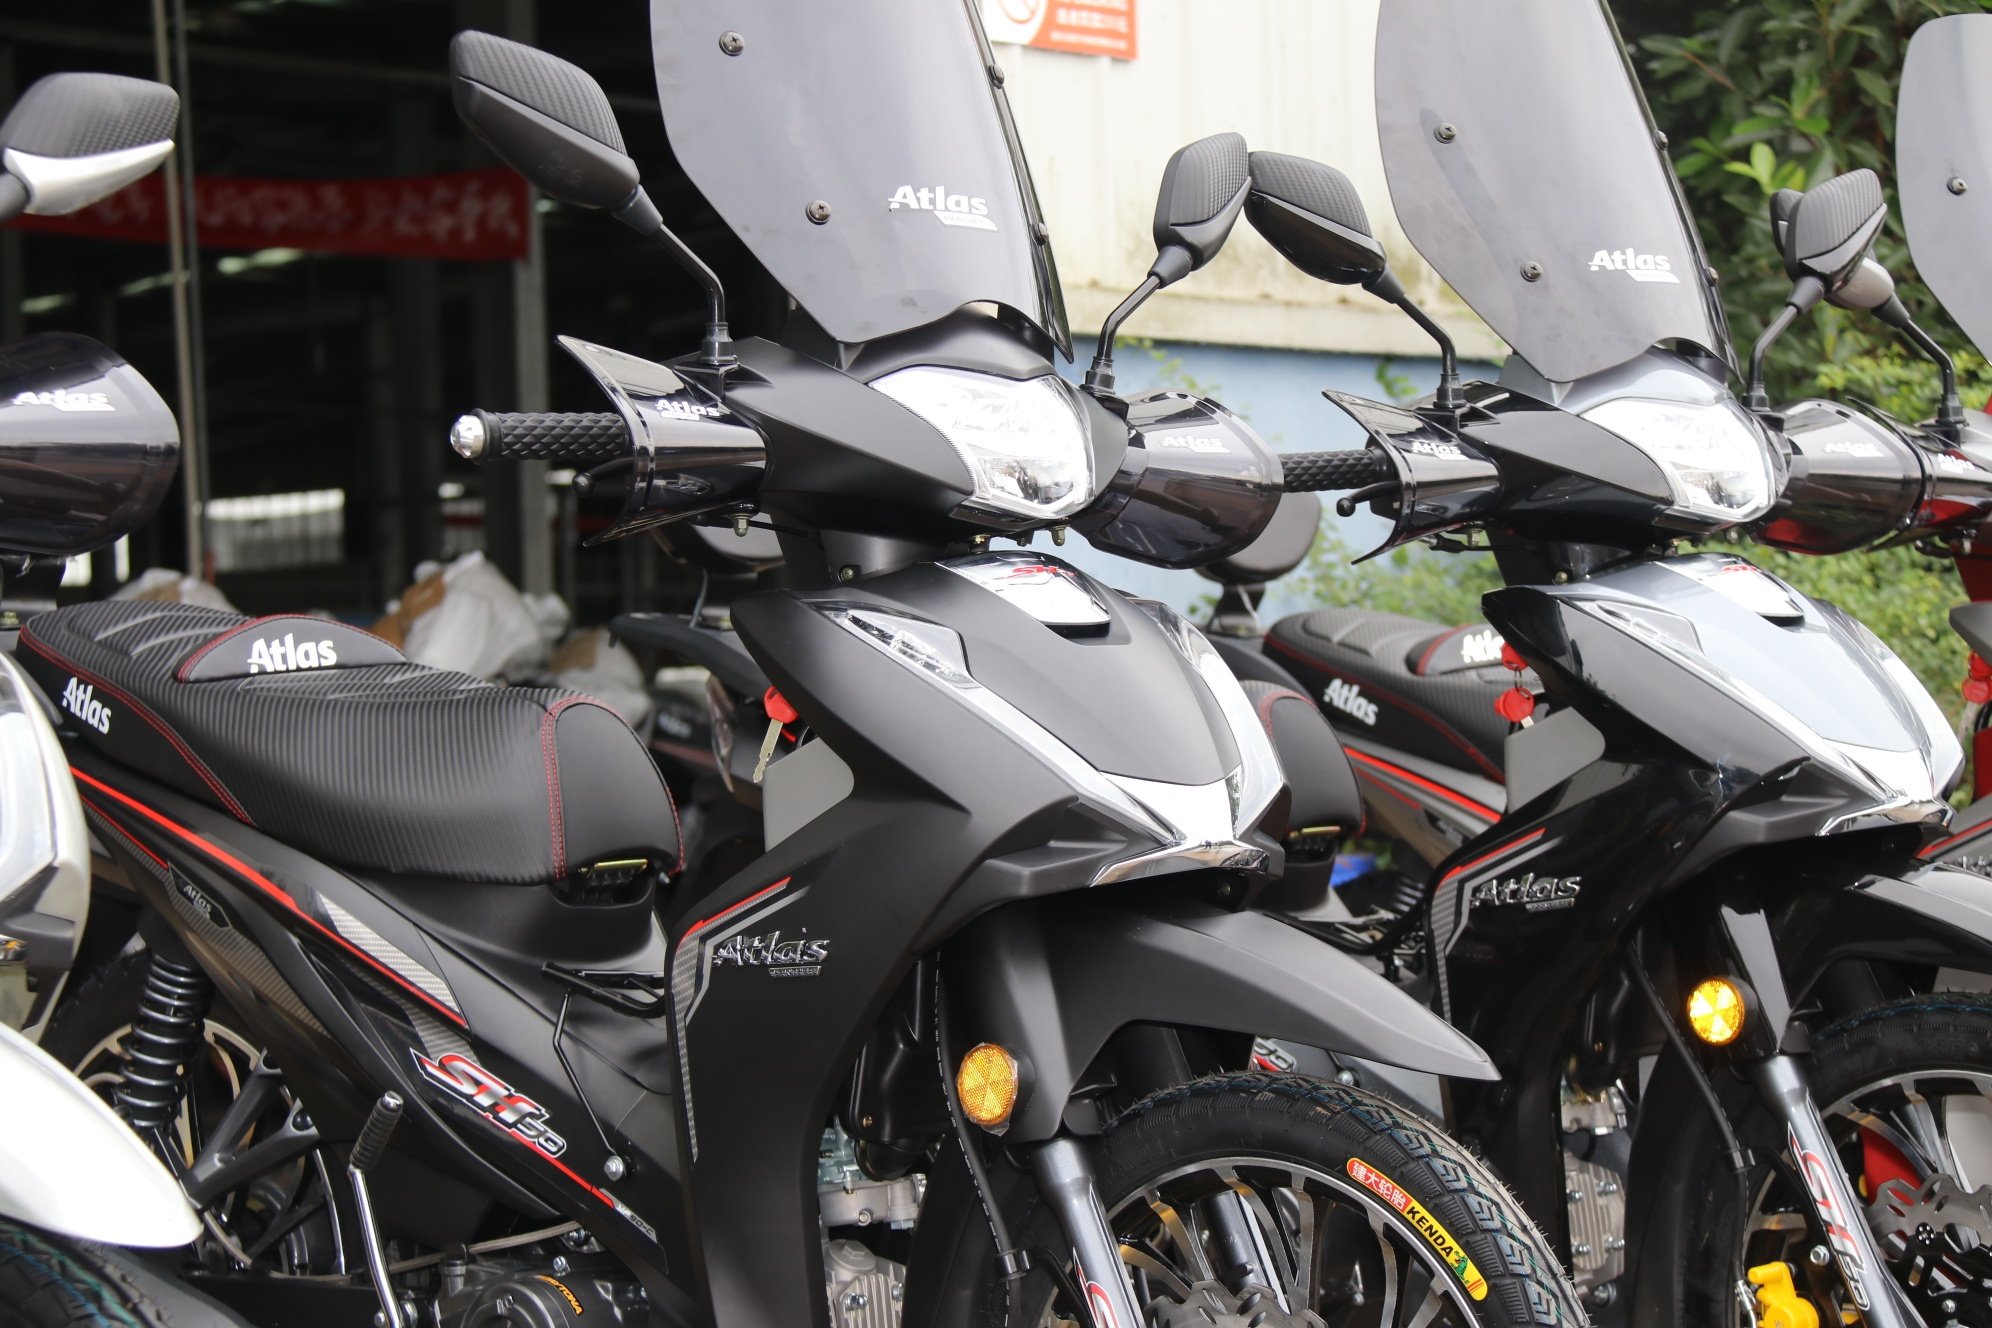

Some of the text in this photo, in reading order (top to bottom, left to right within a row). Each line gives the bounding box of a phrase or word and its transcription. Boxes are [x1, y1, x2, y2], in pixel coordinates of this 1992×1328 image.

[888, 185, 989, 216] Atlas
[1588, 248, 1671, 271] Atlas
[12, 389, 108, 406] Atlas
[655, 399, 720, 417] Atlas
[1160, 435, 1223, 447] Atlas
[1411, 442, 1461, 454] Atlas
[247, 633, 337, 673] Atlas
[1461, 629, 1505, 663] Atla
[62, 677, 112, 735] Atlas
[1323, 678, 1378, 727] Atlas
[1469, 873, 1582, 909] Atlas
[1352, 1161, 1455, 1258] 建大轮胎 KENDA
